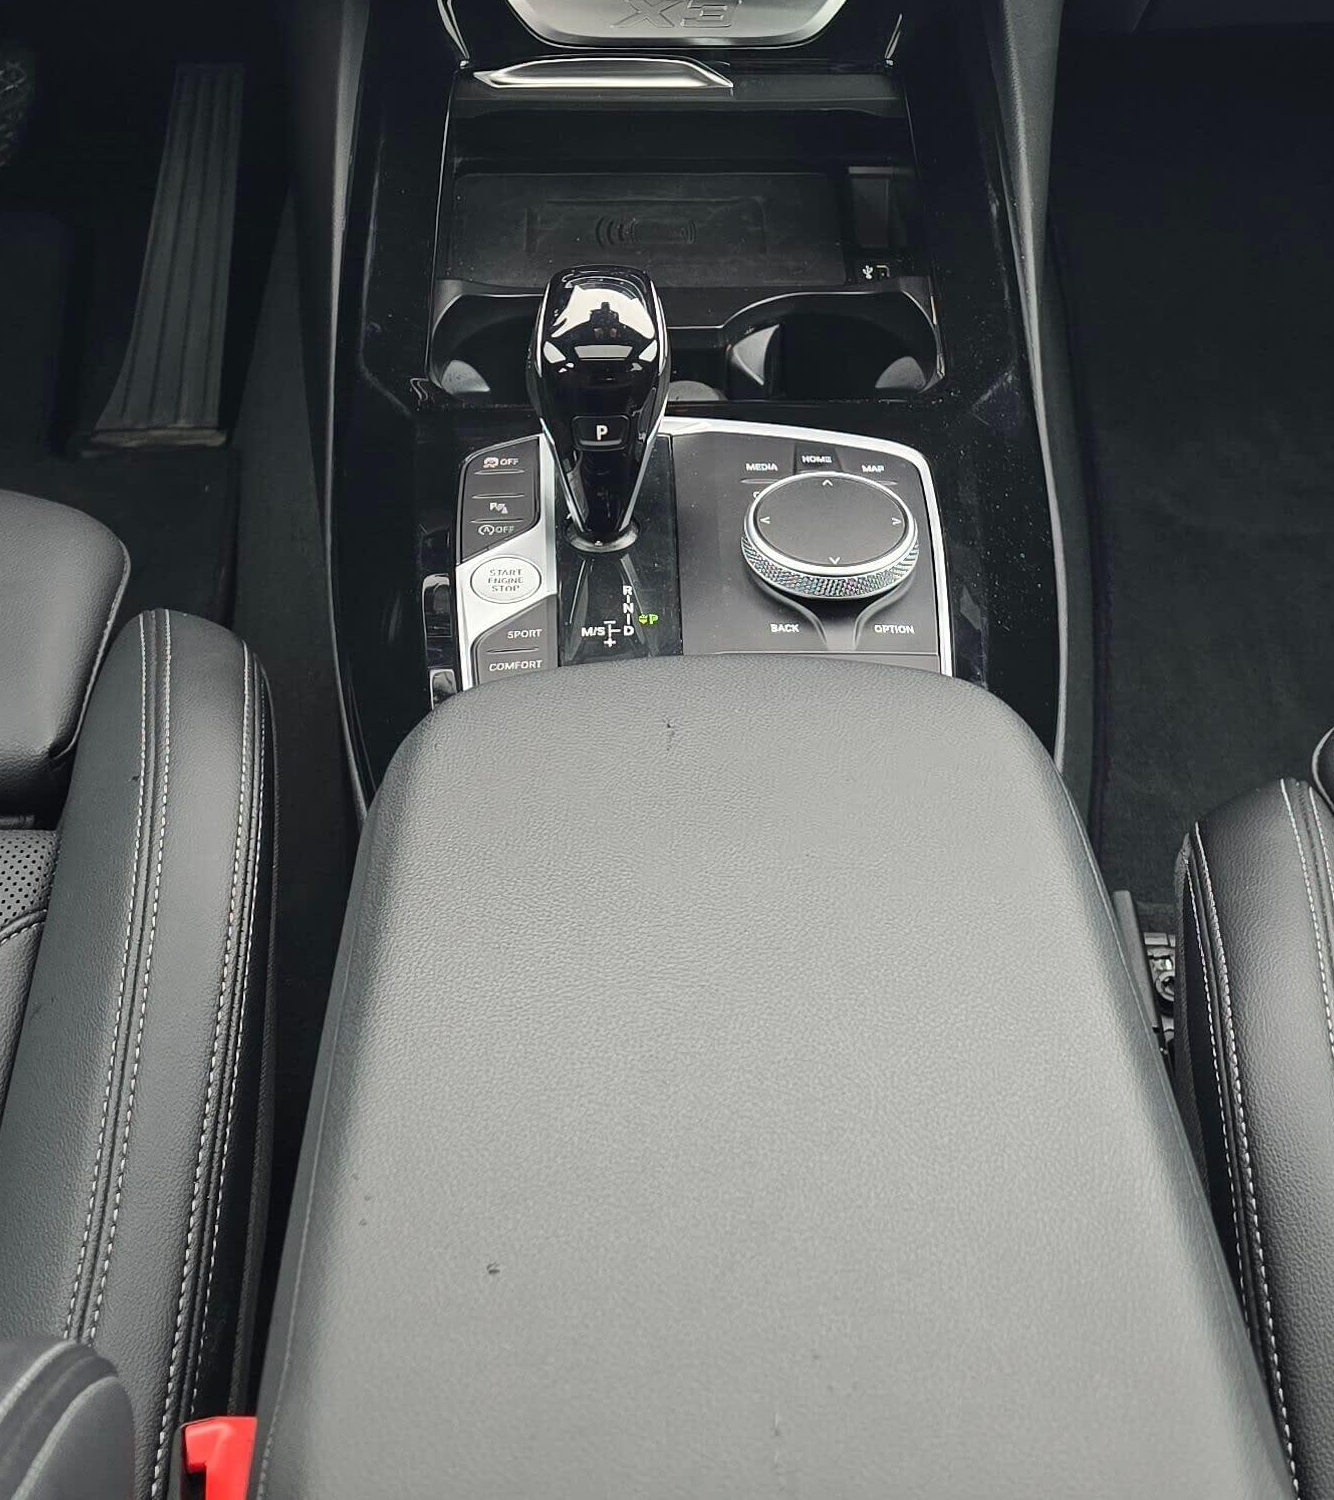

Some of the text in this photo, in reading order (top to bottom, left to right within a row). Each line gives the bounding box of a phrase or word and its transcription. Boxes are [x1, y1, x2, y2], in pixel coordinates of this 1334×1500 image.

[596, 424, 609, 441] P
[499, 458, 519, 467] OFF
[745, 462, 778, 472] MEDIA
[861, 464, 885, 473] MAP
[495, 525, 515, 534] OFF
[488, 568, 523, 577] START
[486, 576, 524, 585] ENGINE
[491, 584, 521, 593] STOP
[622, 585, 633, 596] R
[622, 603, 635, 614] N
[648, 614, 659, 625] P
[580, 626, 606, 638] M/S
[623, 626, 635, 637] D
[770, 623, 800, 633] BACK
[874, 624, 915, 635] OPTION
[506, 628, 543, 640] SPORT
[488, 659, 543, 672] COMFORT
